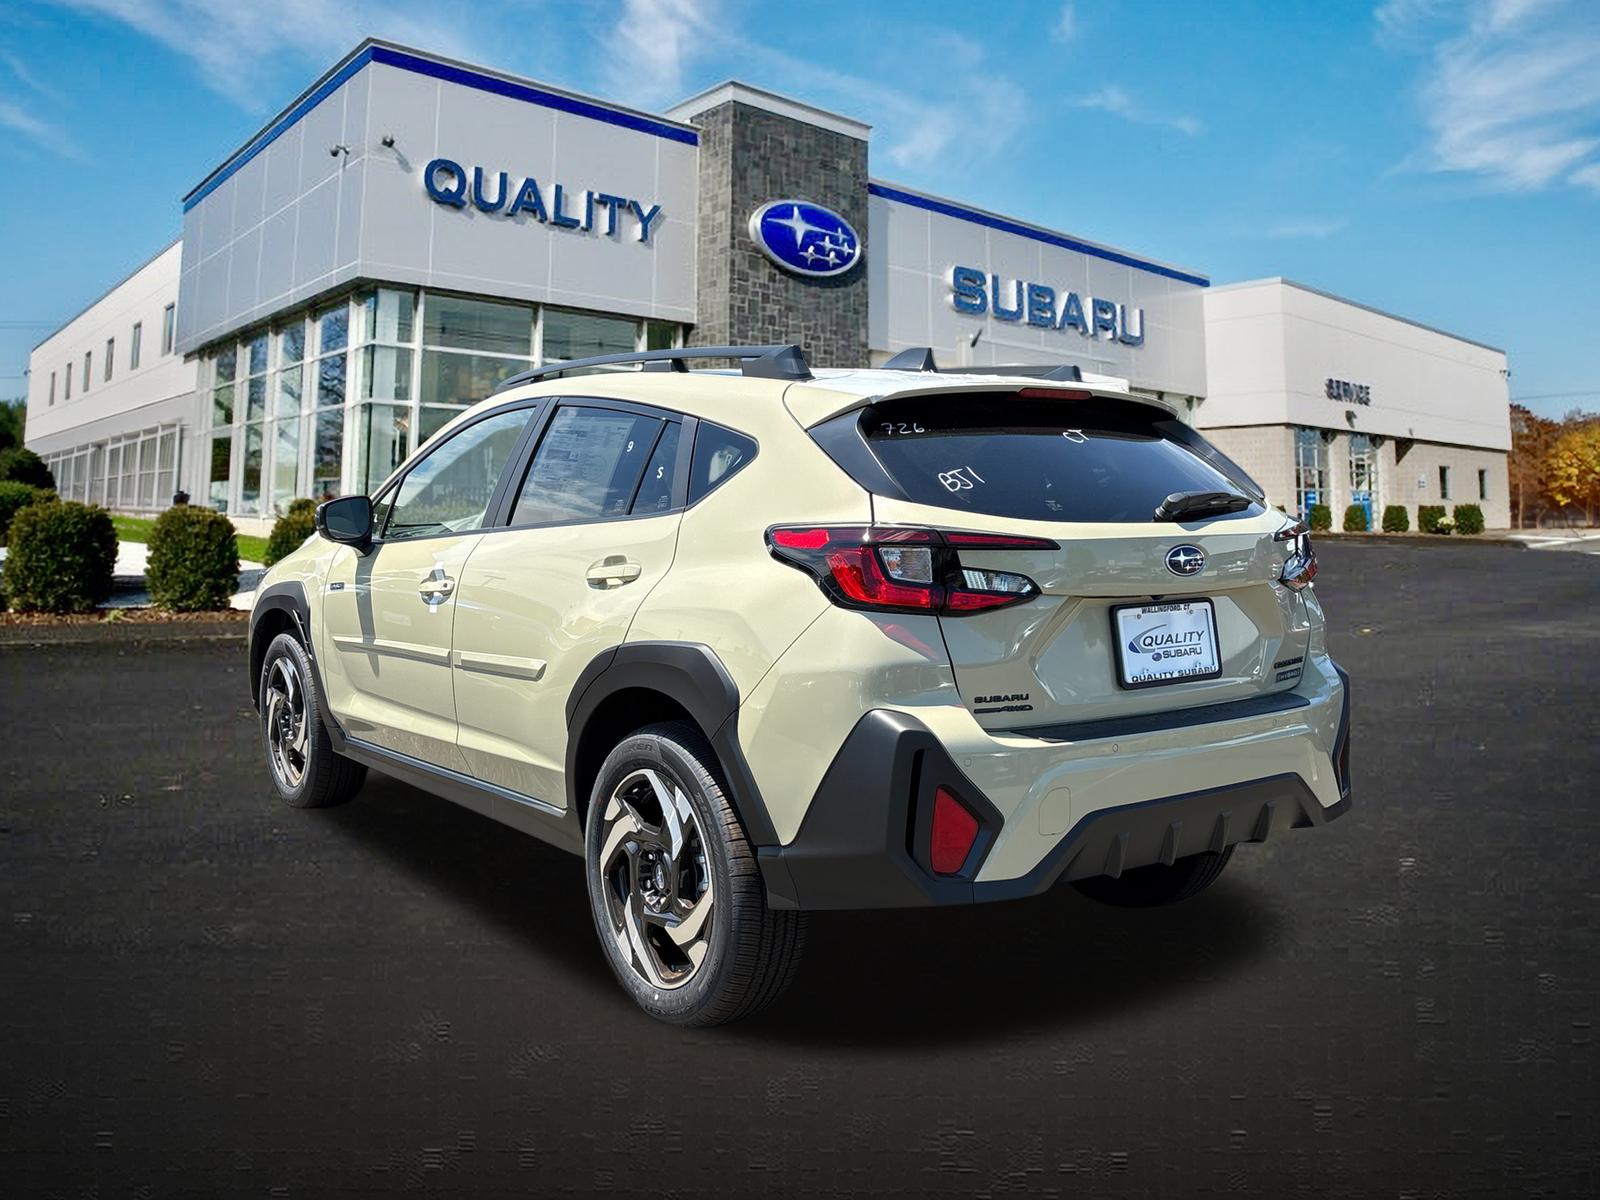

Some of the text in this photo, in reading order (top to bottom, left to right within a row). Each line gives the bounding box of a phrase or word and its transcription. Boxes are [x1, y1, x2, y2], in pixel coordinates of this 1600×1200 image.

[424, 158, 661, 242] QUALITY
[952, 265, 1145, 347] SUBARU
[881, 422, 925, 436] 726
[1142, 630, 1205, 647] QUALITY
[1163, 647, 1202, 659] SUBARU
[1131, 665, 1217, 683] QUALITY SUBARU
[974, 693, 1029, 704] SUBARU
